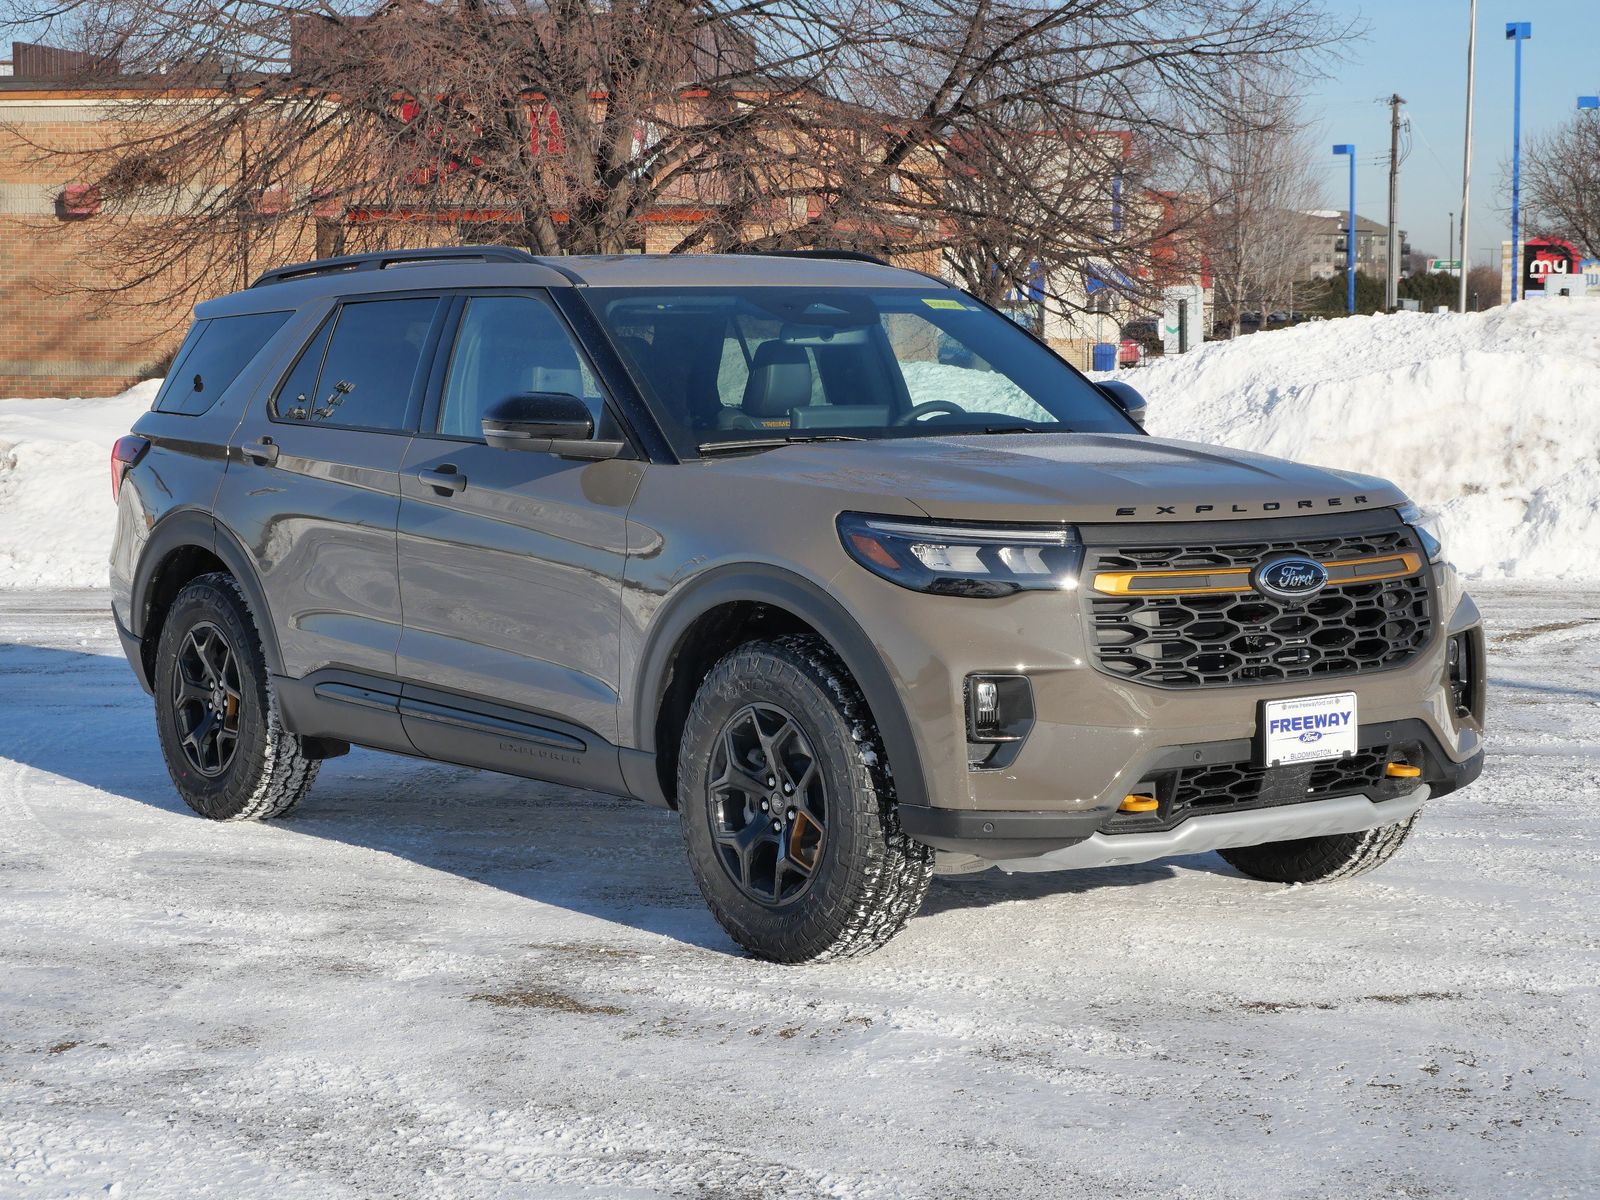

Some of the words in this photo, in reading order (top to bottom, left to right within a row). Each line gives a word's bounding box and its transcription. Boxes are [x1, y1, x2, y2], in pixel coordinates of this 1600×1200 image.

[1530, 260, 1567, 274] my
[1115, 495, 1368, 516] EXPLORER
[1279, 565, 1315, 587] Ford
[1270, 711, 1352, 734] FREEWAY
[1302, 732, 1320, 741] Ford
[1290, 749, 1332, 759] BLOOMINGTON
